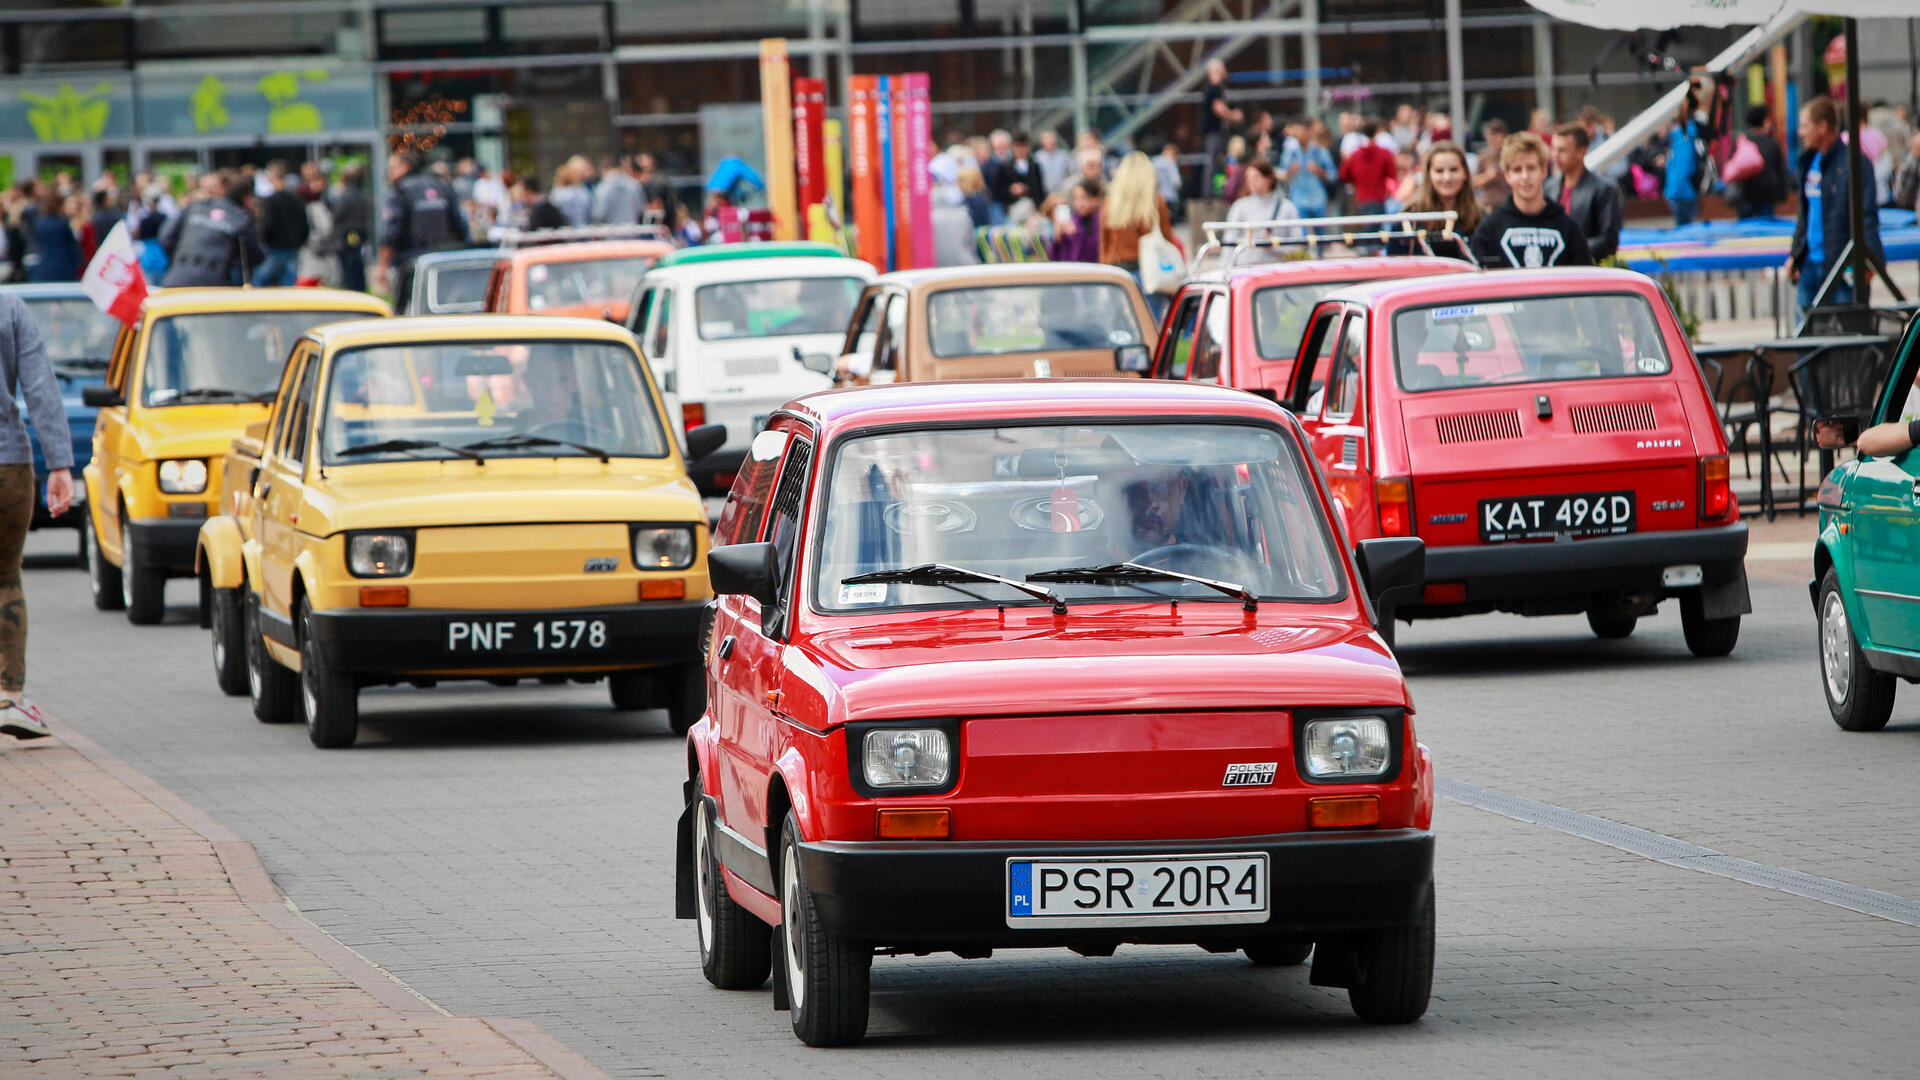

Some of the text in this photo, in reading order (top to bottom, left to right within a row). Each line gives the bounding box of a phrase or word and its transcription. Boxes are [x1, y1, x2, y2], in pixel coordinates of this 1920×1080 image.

[1485, 500, 1545, 531] KAT
[1555, 495, 1631, 527] 496D
[449, 620, 606, 651] PNF 1578
[1226, 773, 1271, 784] FIAT
[1230, 764, 1274, 772] POLSKI
[1040, 864, 1257, 909] PSR 20R4
[1014, 895, 1029, 906] PL
